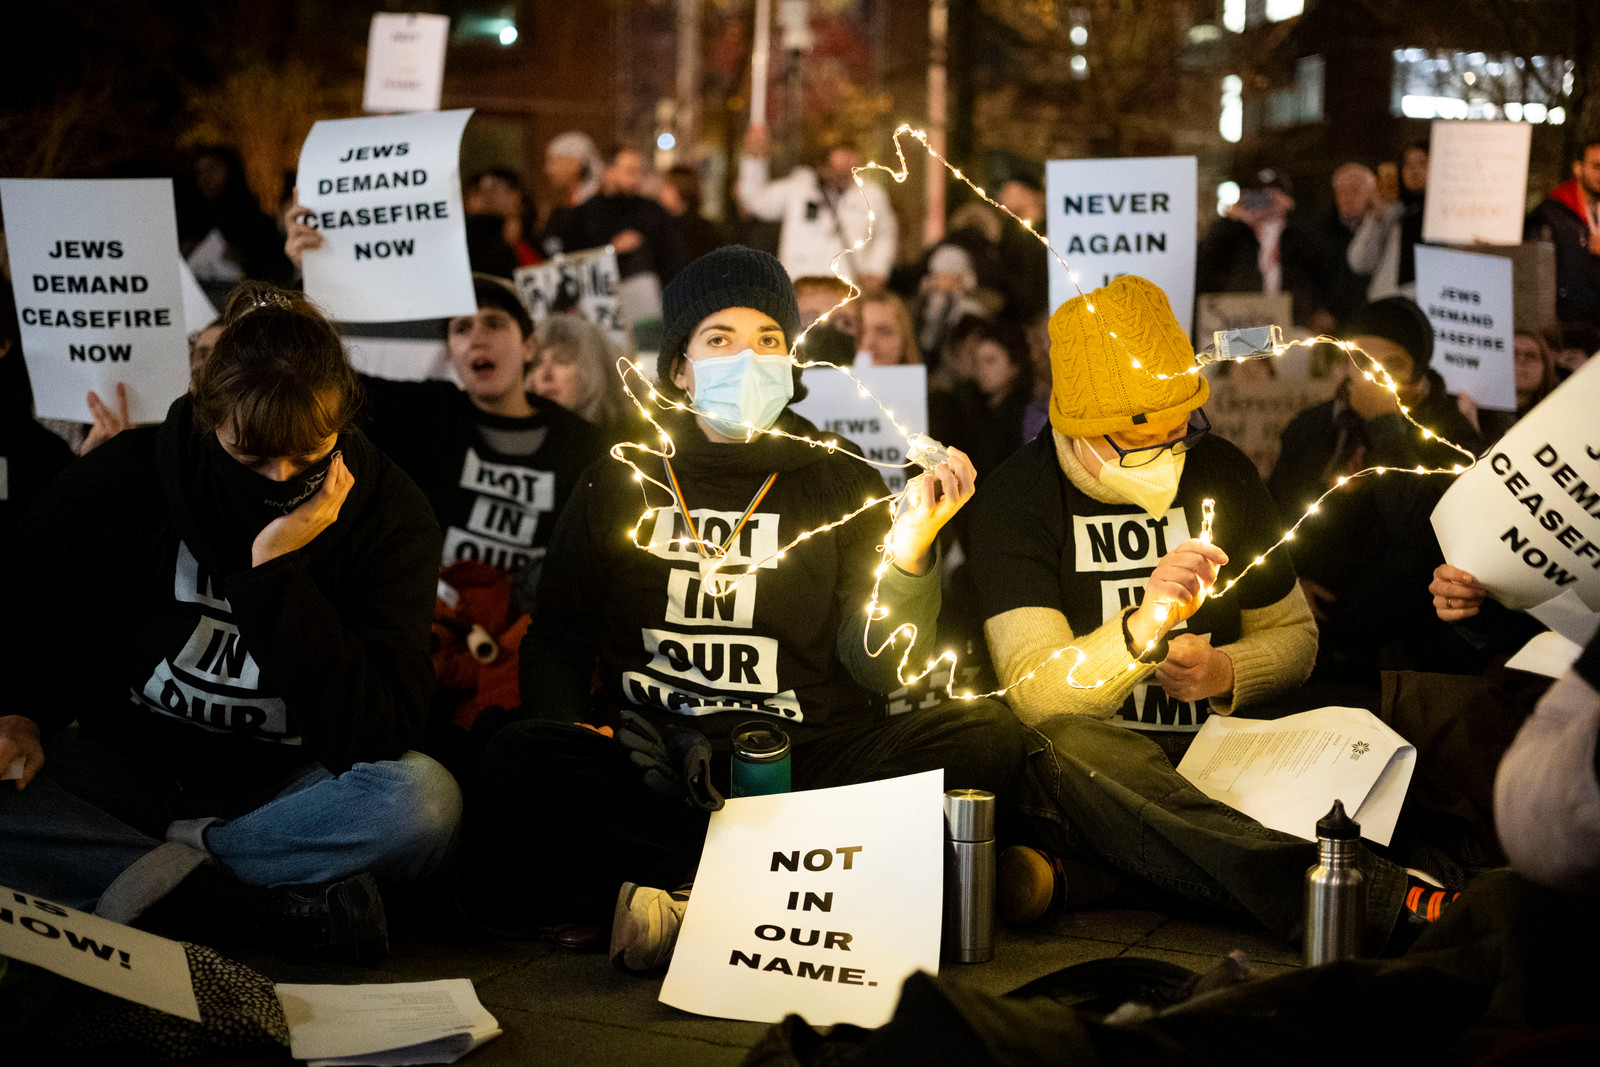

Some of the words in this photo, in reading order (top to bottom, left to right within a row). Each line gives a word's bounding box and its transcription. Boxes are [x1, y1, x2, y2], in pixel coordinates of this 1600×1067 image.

[339, 142, 410, 163] JEWS
[318, 169, 428, 195] DEMAND
[303, 201, 449, 230] CEASEFIRE
[1064, 193, 1170, 215] NEVER
[49, 240, 124, 259] JEWS
[354, 239, 415, 261] NOW
[1068, 233, 1167, 254] AGAIN
[33, 275, 149, 294] DEMAND
[1103, 273, 1128, 288] I
[1442, 286, 1481, 304] JEWS
[22, 308, 172, 328] CEASEFIRE
[1429, 304, 1494, 329] DEMAND
[69, 343, 132, 363] NOW
[1445, 352, 1480, 370] NOW
[484, 503, 525, 536] IN
[668, 511, 760, 558] NOT
[1086, 516, 1169, 563] NOT
[1500, 526, 1578, 587] NOW
[684, 577, 738, 622] IN
[195, 628, 248, 679] IN
[658, 639, 761, 685] OUR
[770, 845, 863, 872] NOT
[13, 892, 69, 917] IS
[787, 891, 834, 912] IN
[754, 924, 853, 951] OUR
[729, 950, 878, 987] NAME.
